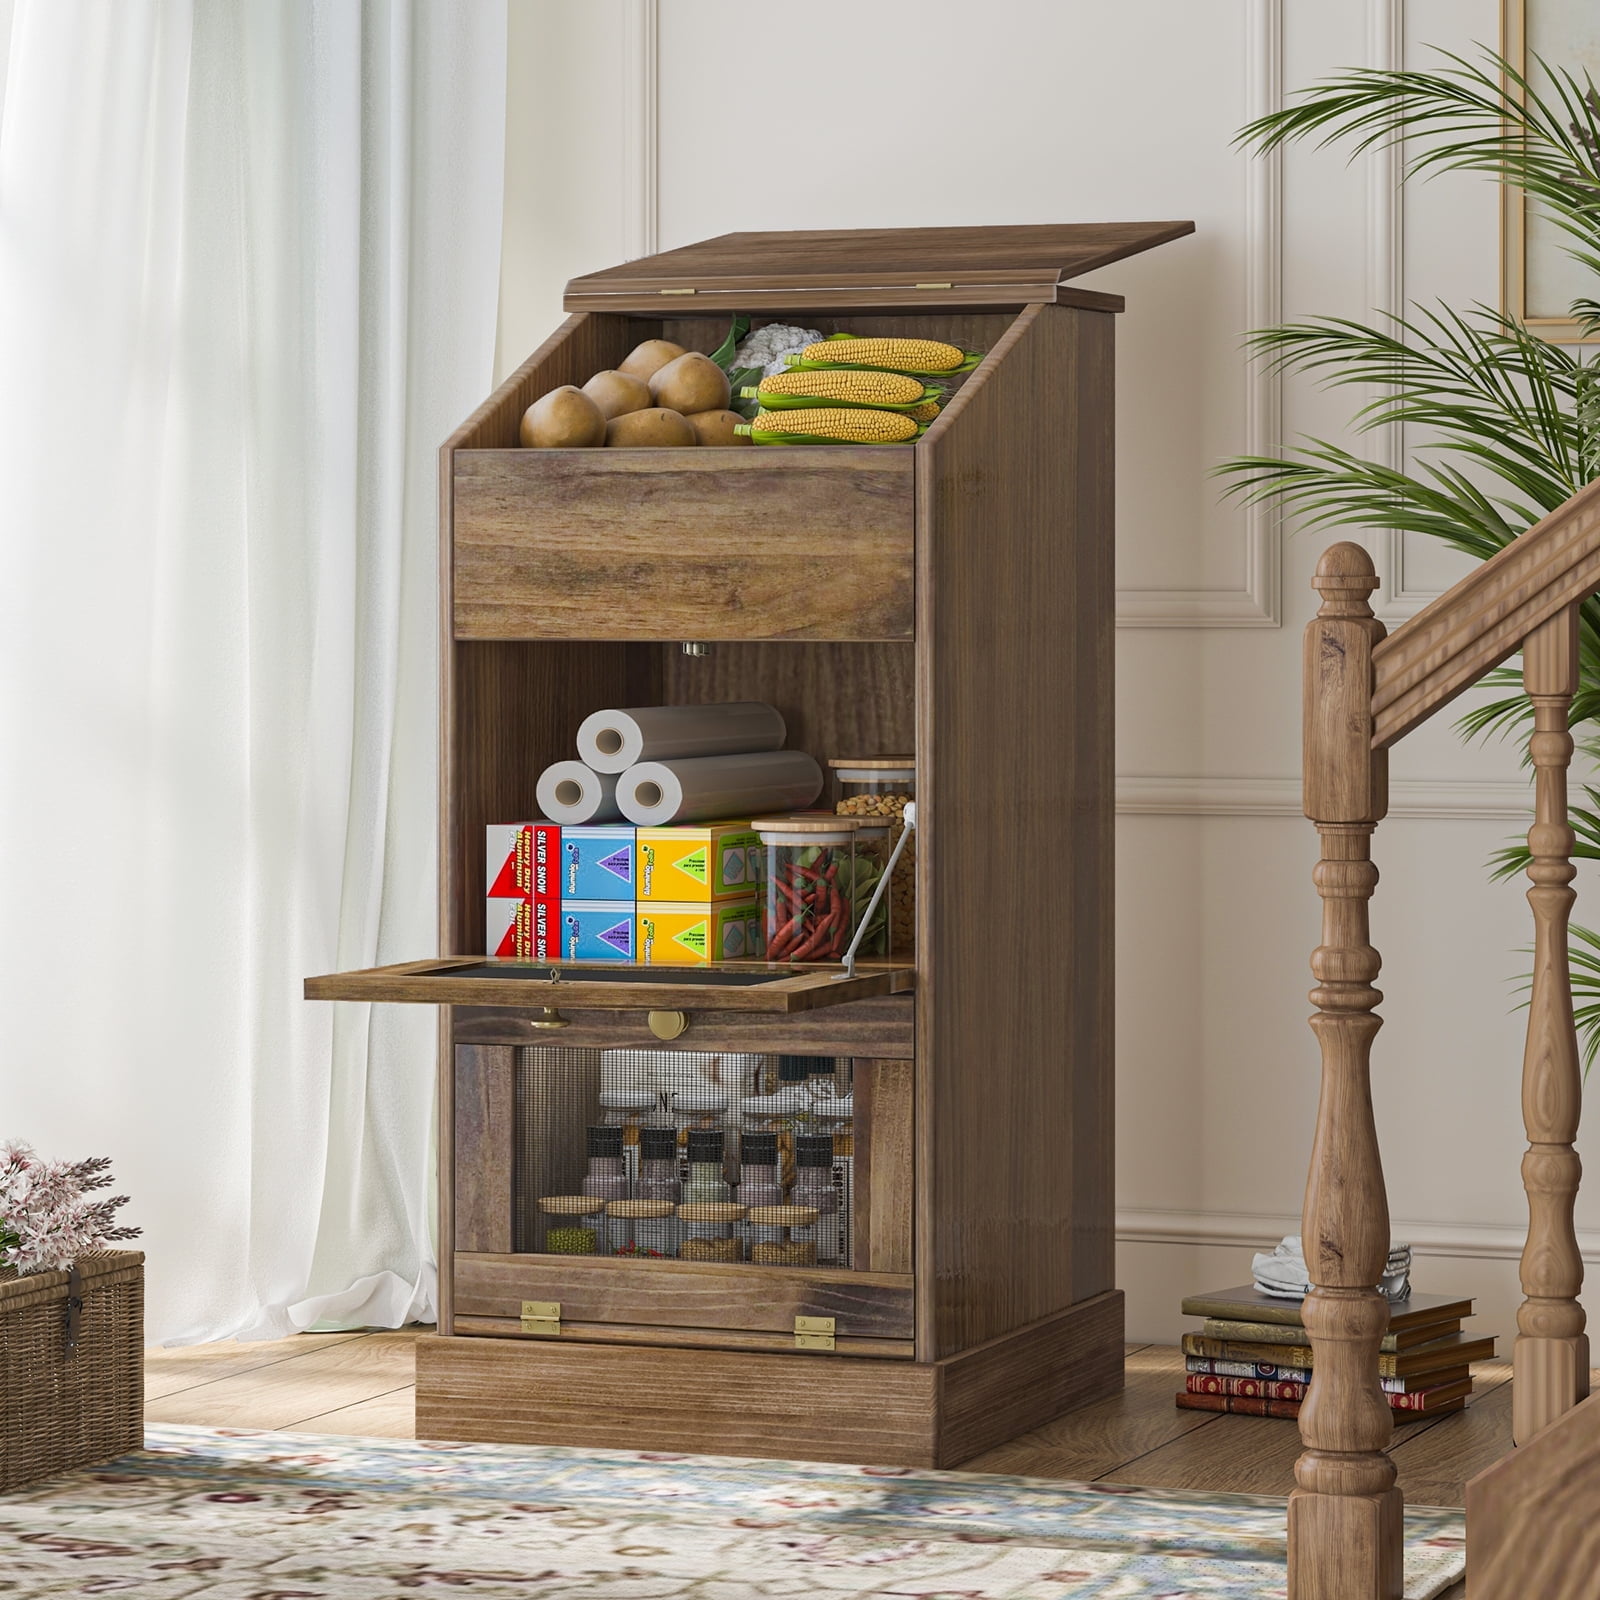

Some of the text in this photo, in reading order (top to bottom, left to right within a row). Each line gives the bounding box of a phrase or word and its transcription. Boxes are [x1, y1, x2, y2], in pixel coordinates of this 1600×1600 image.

[537, 830, 546, 894] SILVER SNOW
[537, 903, 546, 937] SILVER
